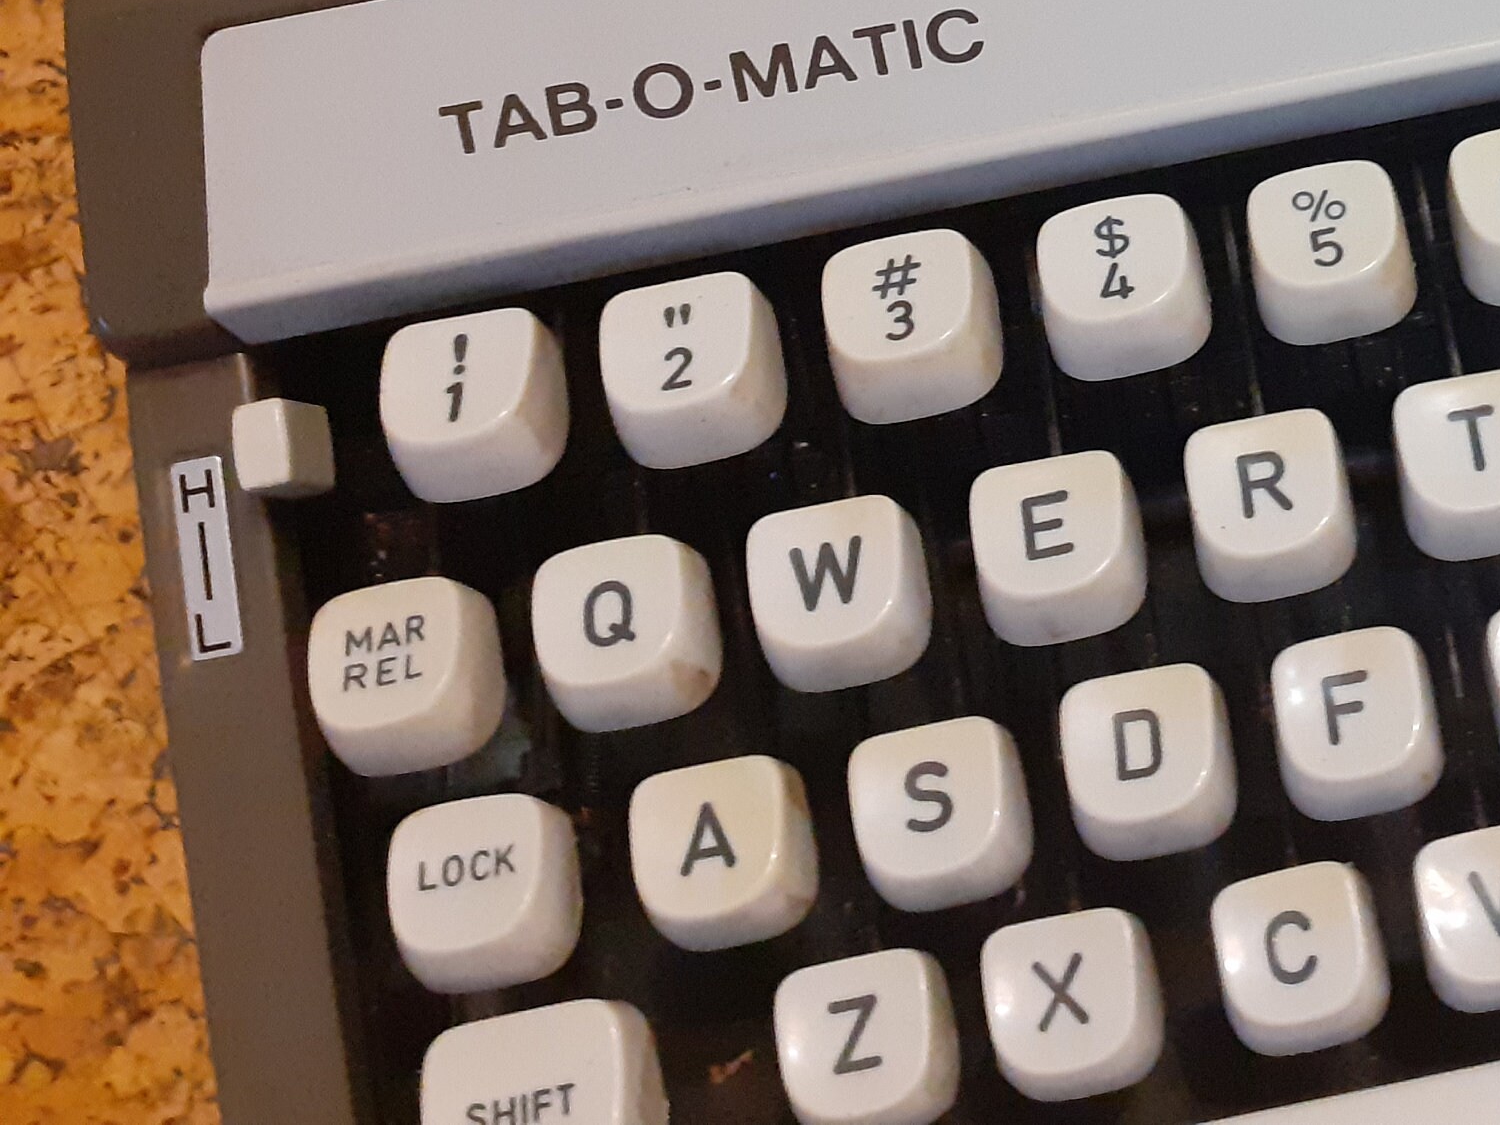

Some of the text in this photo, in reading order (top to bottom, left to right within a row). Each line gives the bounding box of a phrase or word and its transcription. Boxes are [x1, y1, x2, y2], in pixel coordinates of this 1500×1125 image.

[438, 8, 985, 155] TAB-O-MATIC
[1291, 189, 1347, 223] %
[1093, 215, 1130, 260] $
[1309, 226, 1344, 268] 5
[870, 253, 922, 301] #
[1099, 262, 1136, 300] 4
[884, 300, 916, 342] 3
[452, 333, 469, 376] !
[660, 346, 693, 392] 2
[445, 381, 464, 423] 1
[1447, 404, 1495, 472] T
[177, 468, 217, 515] H
[1236, 450, 1294, 520] R
[1020, 489, 1075, 561] E
[788, 534, 863, 612] W
[197, 612, 234, 655] L
[344, 614, 425, 660] MAR
[582, 580, 637, 648] Q
[342, 650, 423, 692] REL
[1321, 669, 1369, 747] F
[1113, 708, 1164, 782] D
[903, 760, 955, 833] S
[679, 801, 737, 878] A
[417, 844, 516, 892] LOCK
[1263, 909, 1319, 986] C
[1031, 952, 1090, 1033] X
[827, 993, 883, 1076] Z
[465, 1082, 575, 1125] SHIFT
